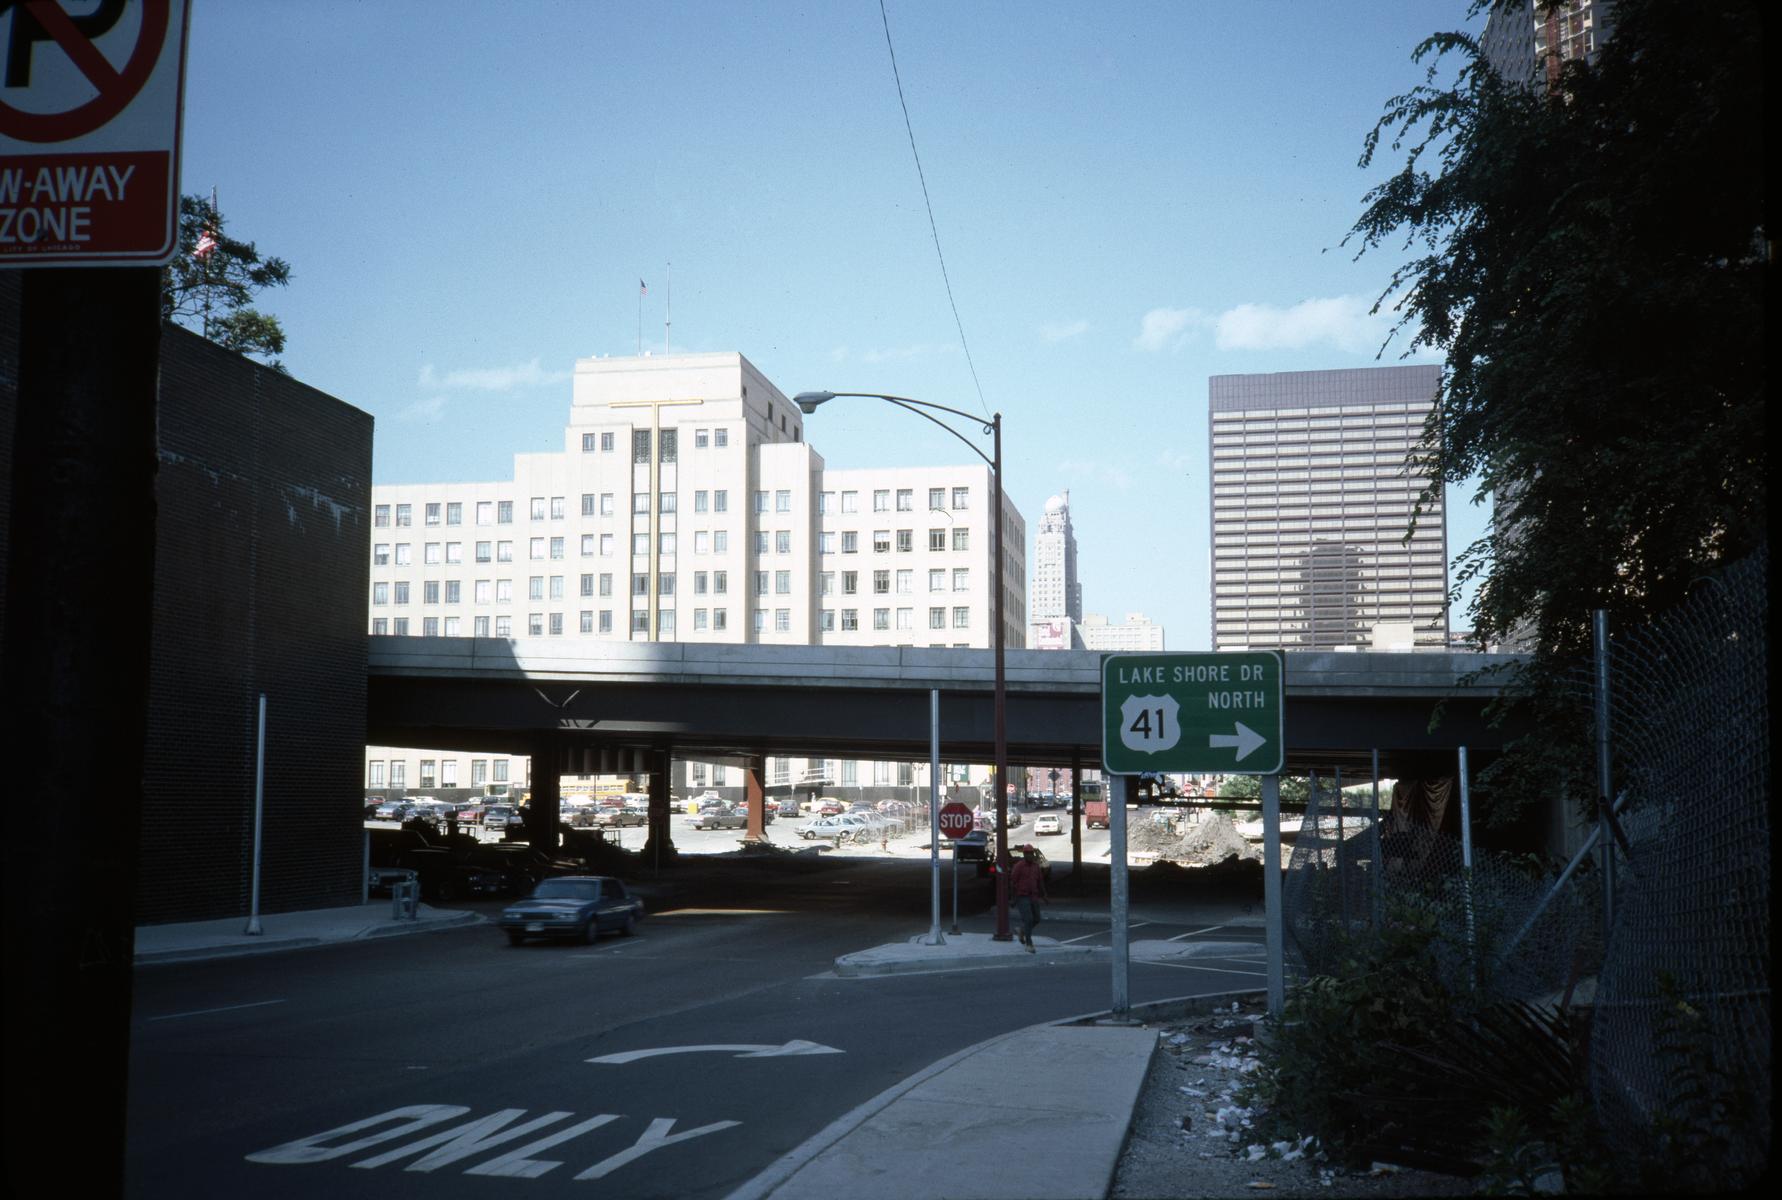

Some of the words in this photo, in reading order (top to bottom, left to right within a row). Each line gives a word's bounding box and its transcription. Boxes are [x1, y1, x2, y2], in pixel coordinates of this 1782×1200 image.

[0, 206, 91, 244] ZONE
[1119, 667, 1165, 684] LAKE
[1173, 665, 1230, 683] SHORE
[1240, 664, 1263, 681] DR
[1208, 691, 1265, 709] NORTH
[1130, 708, 1164, 739] 41
[940, 814, 972, 829] STOP
[243, 1102, 744, 1181] ONLY
